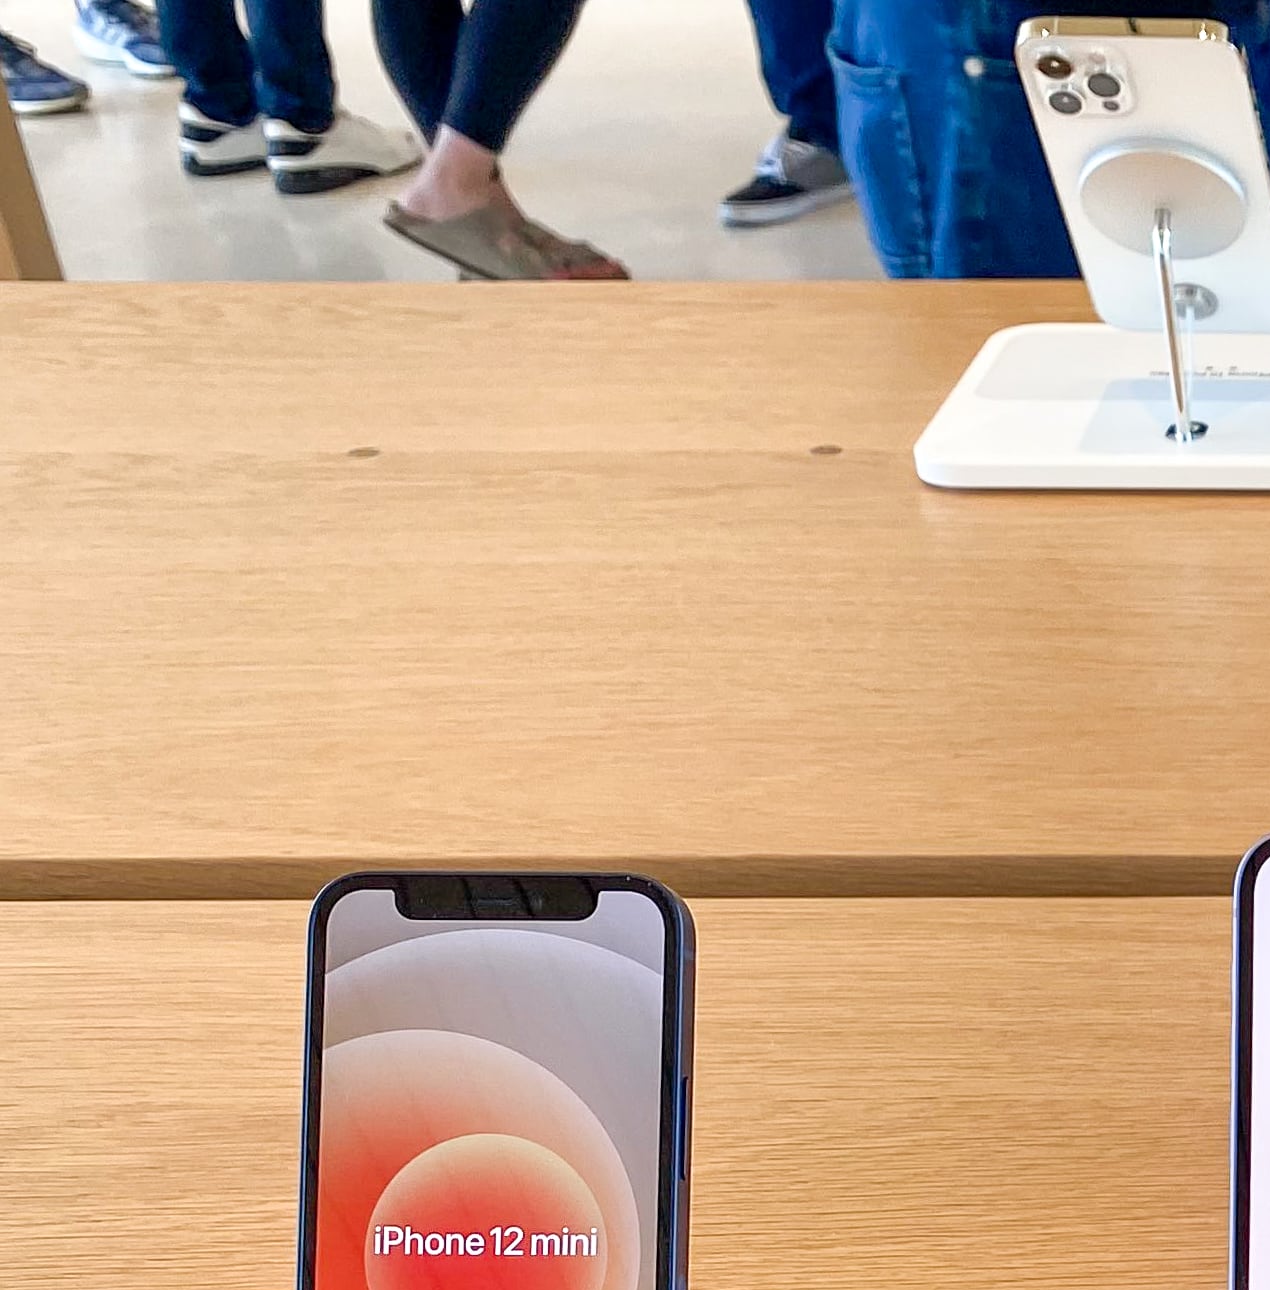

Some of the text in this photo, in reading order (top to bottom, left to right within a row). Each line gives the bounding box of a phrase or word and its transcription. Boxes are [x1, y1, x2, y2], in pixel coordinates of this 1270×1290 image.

[372, 1226, 599, 1256] iPhone 12 mini
